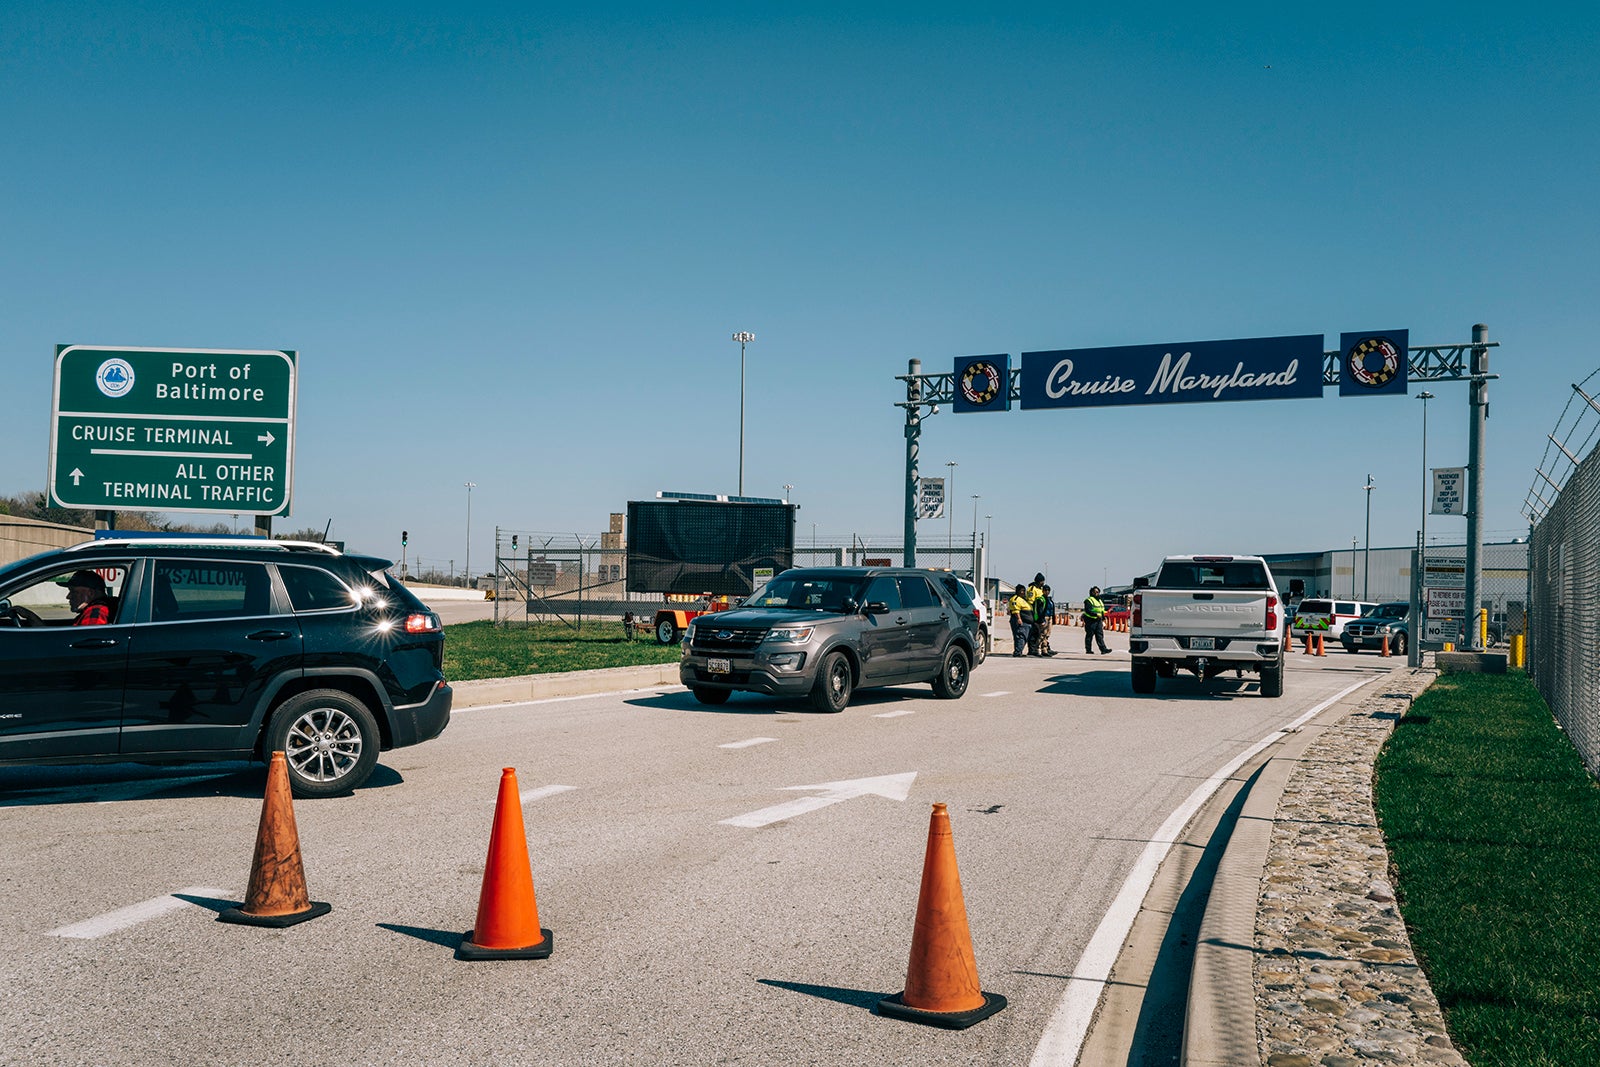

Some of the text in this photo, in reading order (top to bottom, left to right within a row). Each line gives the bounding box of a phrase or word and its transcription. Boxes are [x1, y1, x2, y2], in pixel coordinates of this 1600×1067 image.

[171, 363, 251, 380] Port of
[1045, 351, 1299, 399] Cruise Maryland
[156, 383, 265, 401] Baltimore
[72, 425, 233, 446] CRUISE TERMINAL
[175, 463, 275, 482] ALL OTHER
[103, 481, 274, 503] TERMINAL TRAFFIC
[1150, 605, 1258, 613] EVROLET
[1429, 627, 1440, 635] NO
